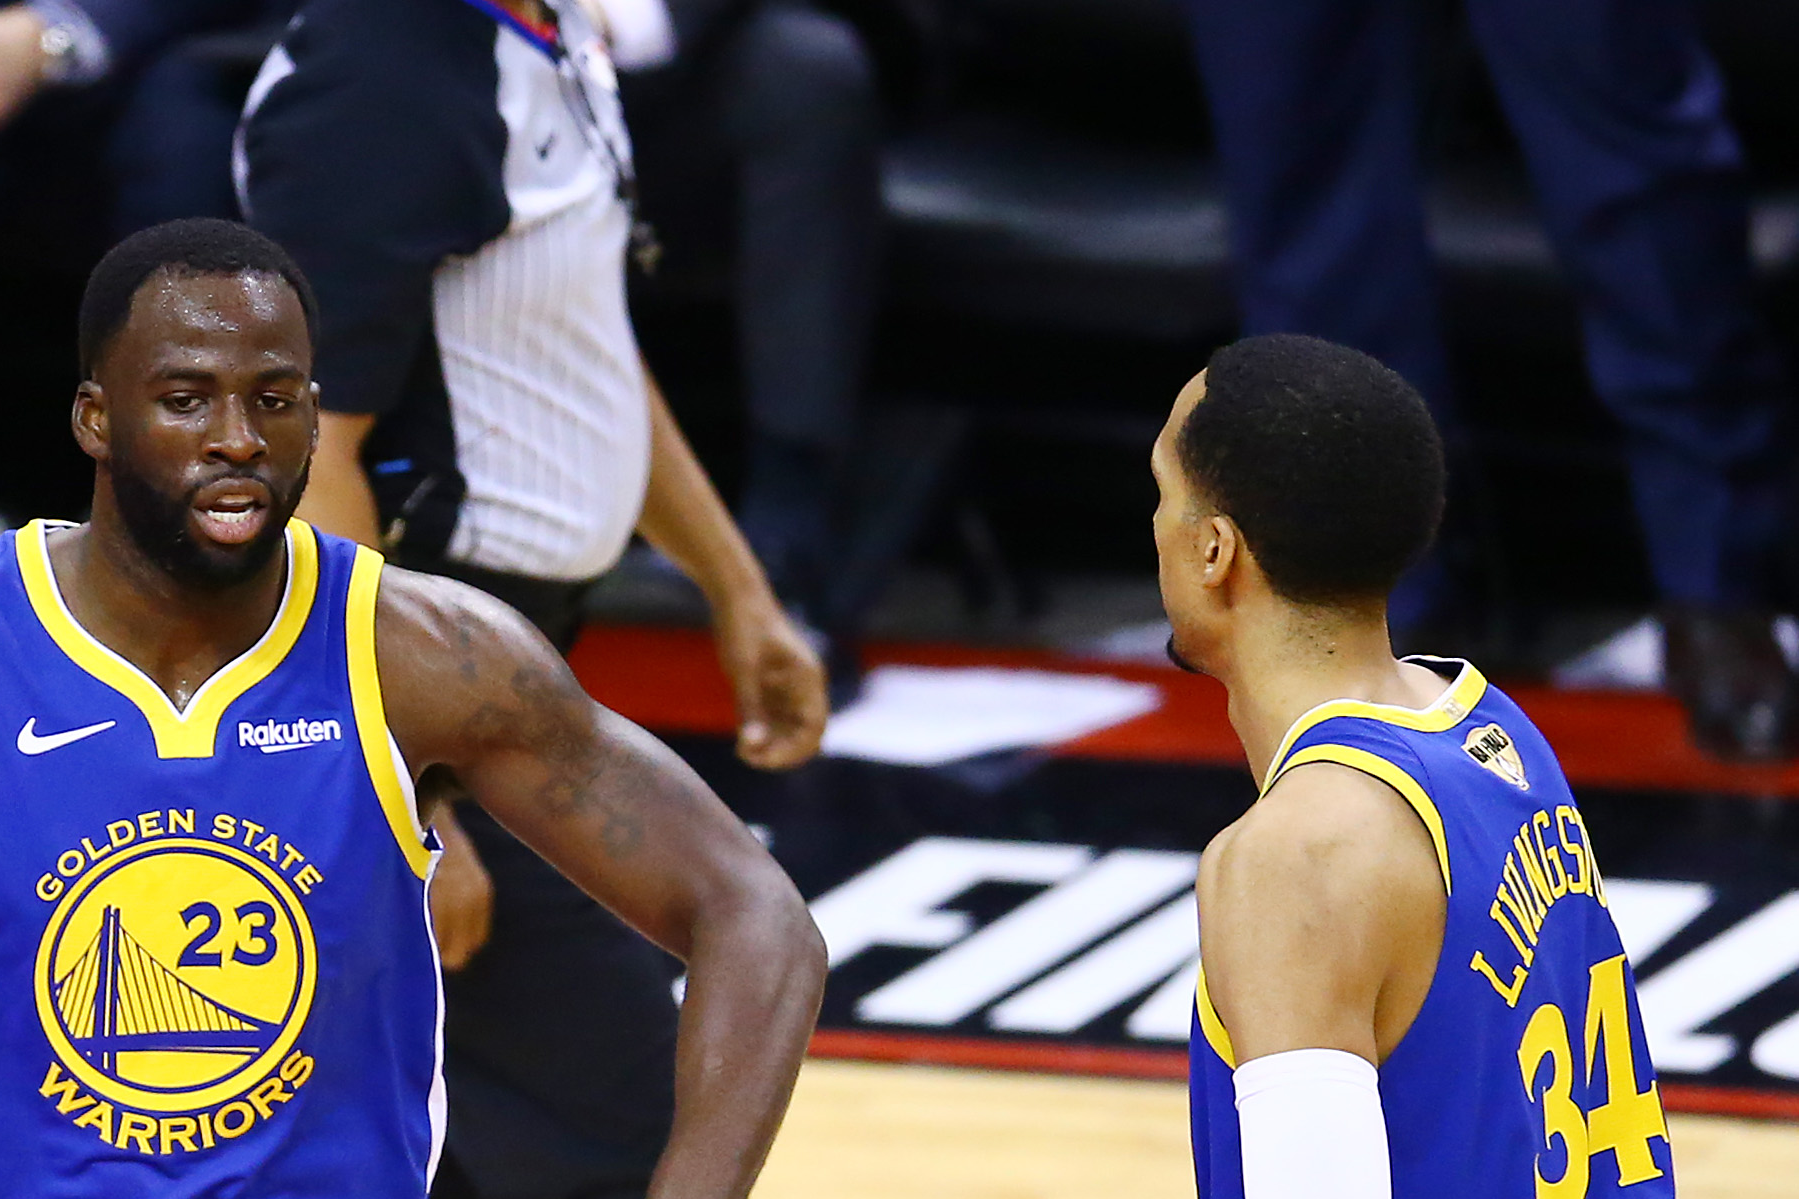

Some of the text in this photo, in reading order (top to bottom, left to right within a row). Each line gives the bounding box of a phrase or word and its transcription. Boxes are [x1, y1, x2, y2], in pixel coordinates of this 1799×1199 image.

[237, 716, 342, 748] Rakuten
[34, 808, 325, 902] GOLDEN STATE
[176, 900, 279, 968] 23
[38, 1049, 316, 1155] WARRIORS
